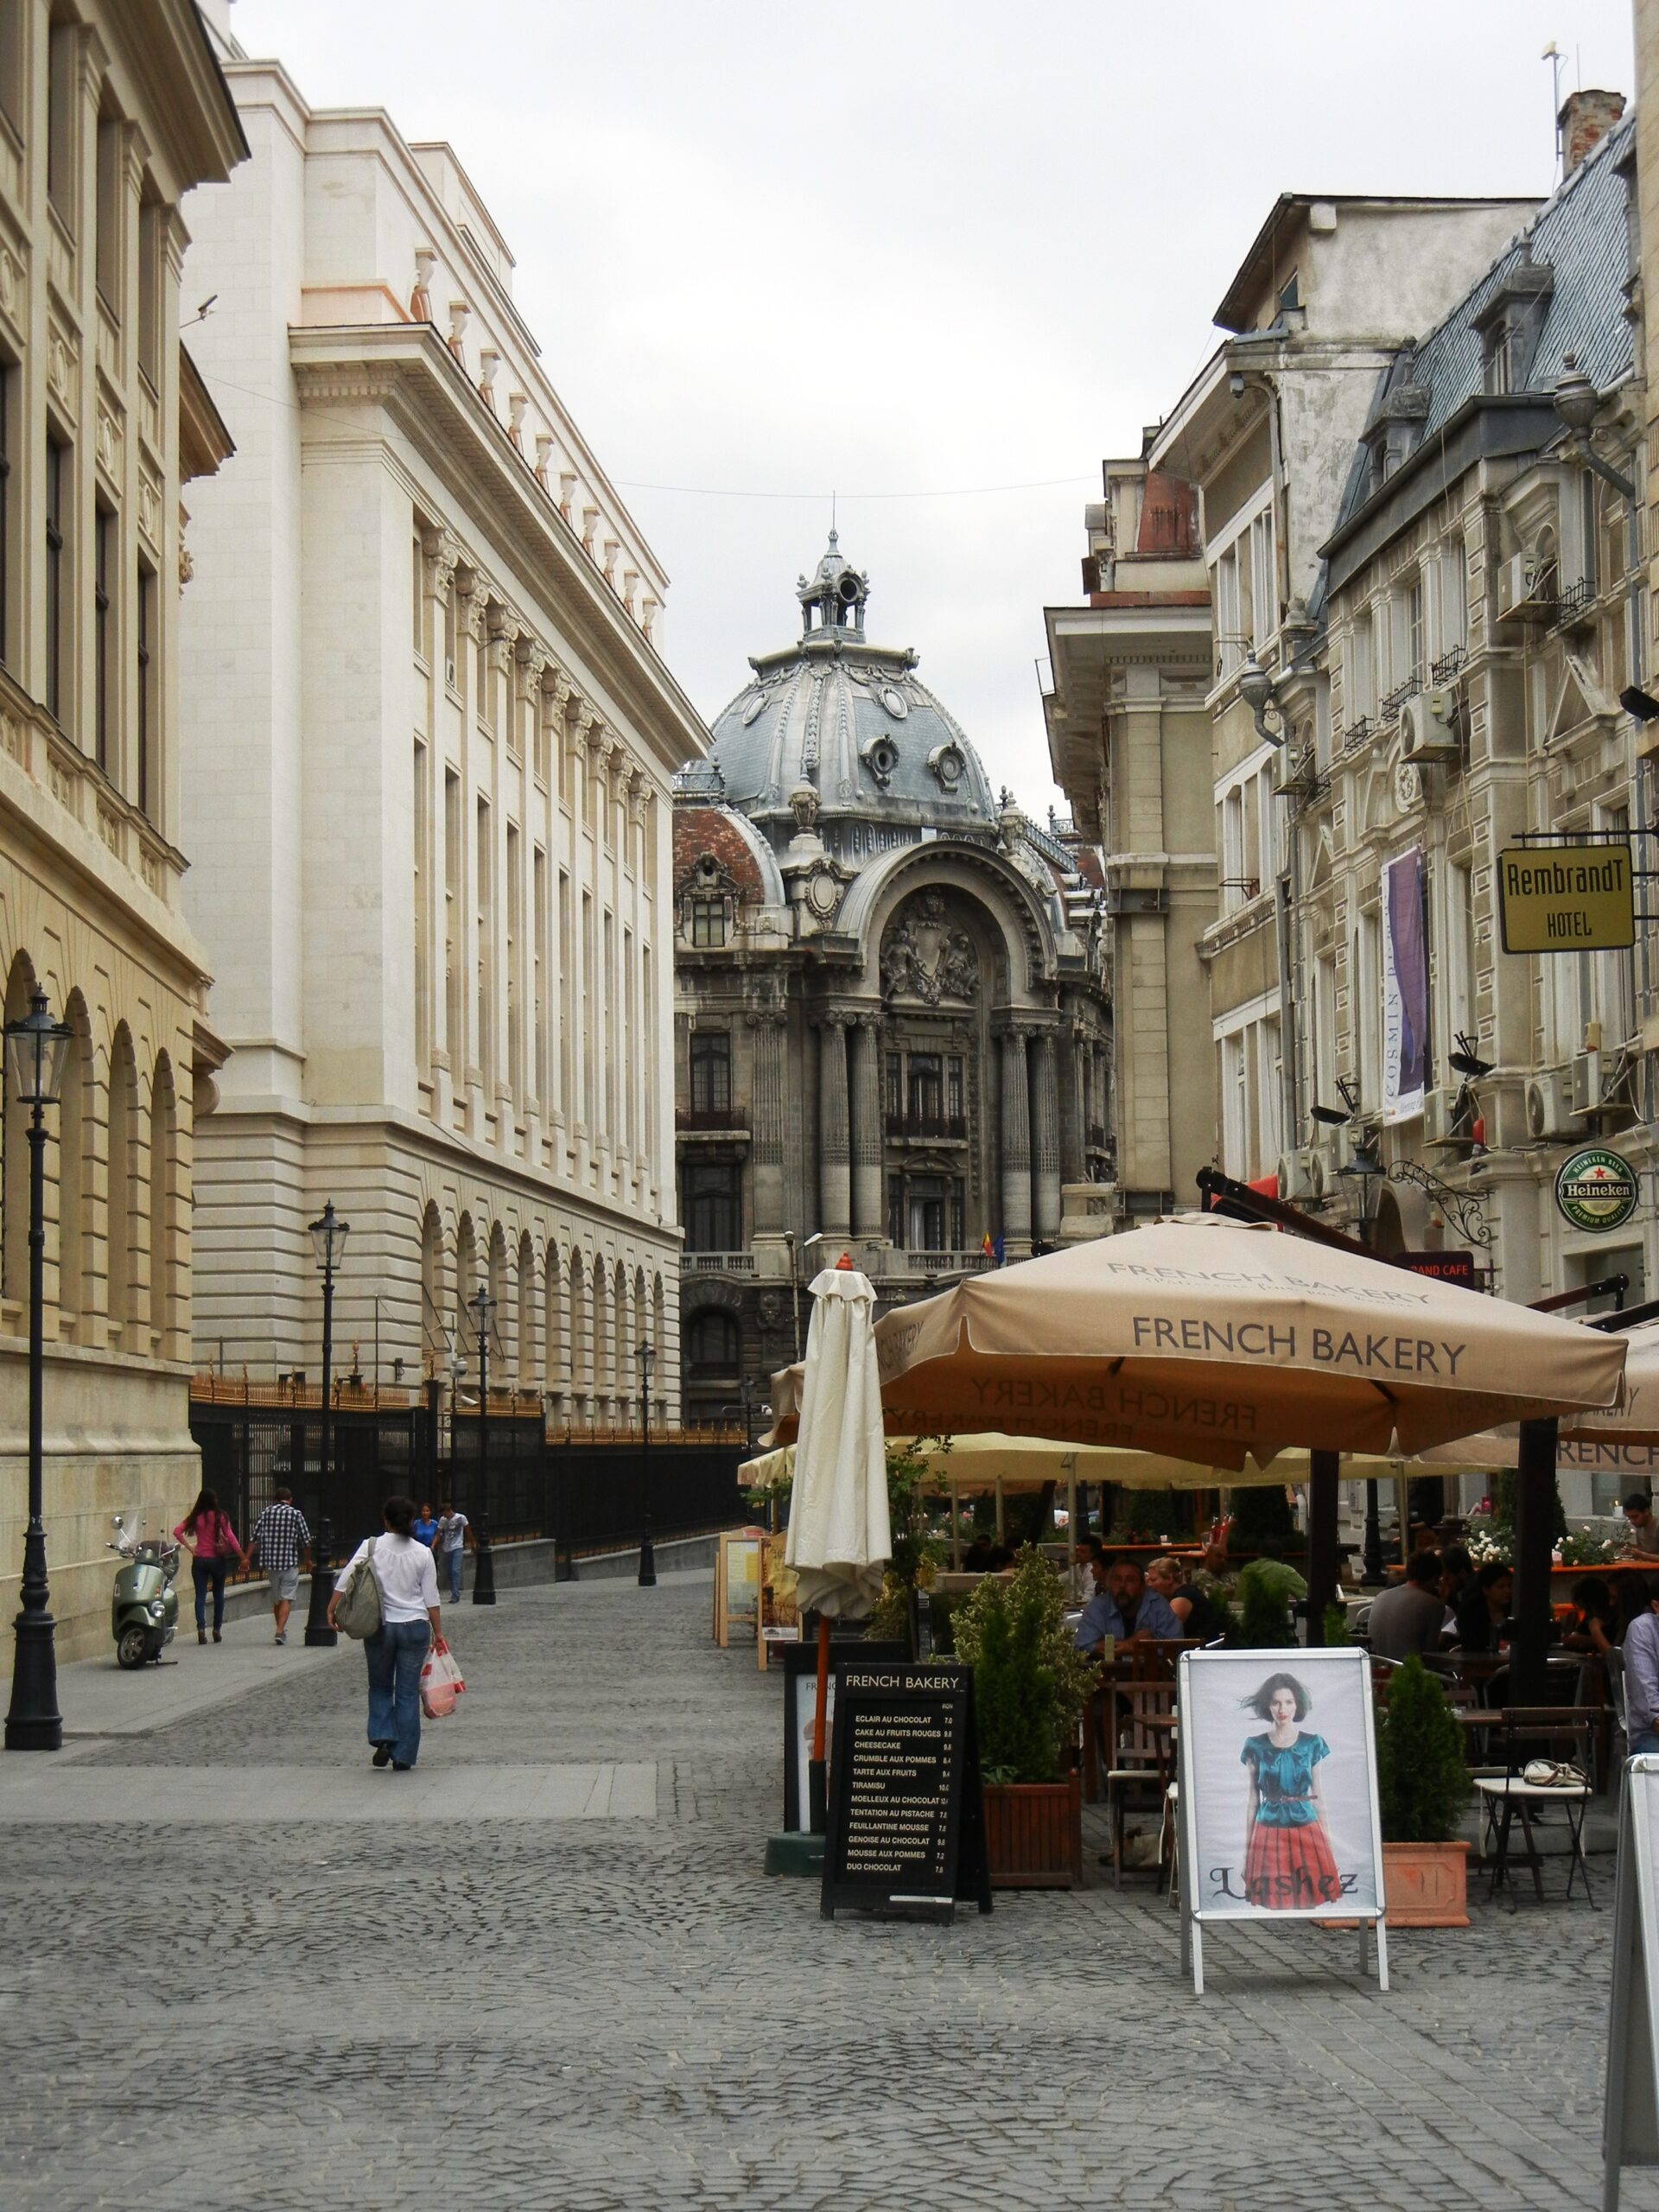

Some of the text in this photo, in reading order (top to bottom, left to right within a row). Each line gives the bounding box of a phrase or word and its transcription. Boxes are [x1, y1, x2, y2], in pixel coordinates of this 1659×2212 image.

[1507, 859, 1623, 896] RembrandT
[1547, 912, 1592, 938] HOTEL
[1385, 993, 1399, 1097] COSMIN
[1573, 1156, 1605, 1173] HEINEKEN
[1567, 1184, 1630, 1197] Heineken
[1572, 1205, 1624, 1224] PREMIUM QUALITY
[1443, 1264, 1468, 1275] CAFE
[1107, 1262, 1274, 1282] FRENCH
[1284, 1275, 1430, 1305] BAKERY
[1133, 1316, 1466, 1376] FRENCH BAKERY
[846, 1675, 959, 1688] FRENCH BAKERY
[1210, 1866, 1359, 1900] Lashez
